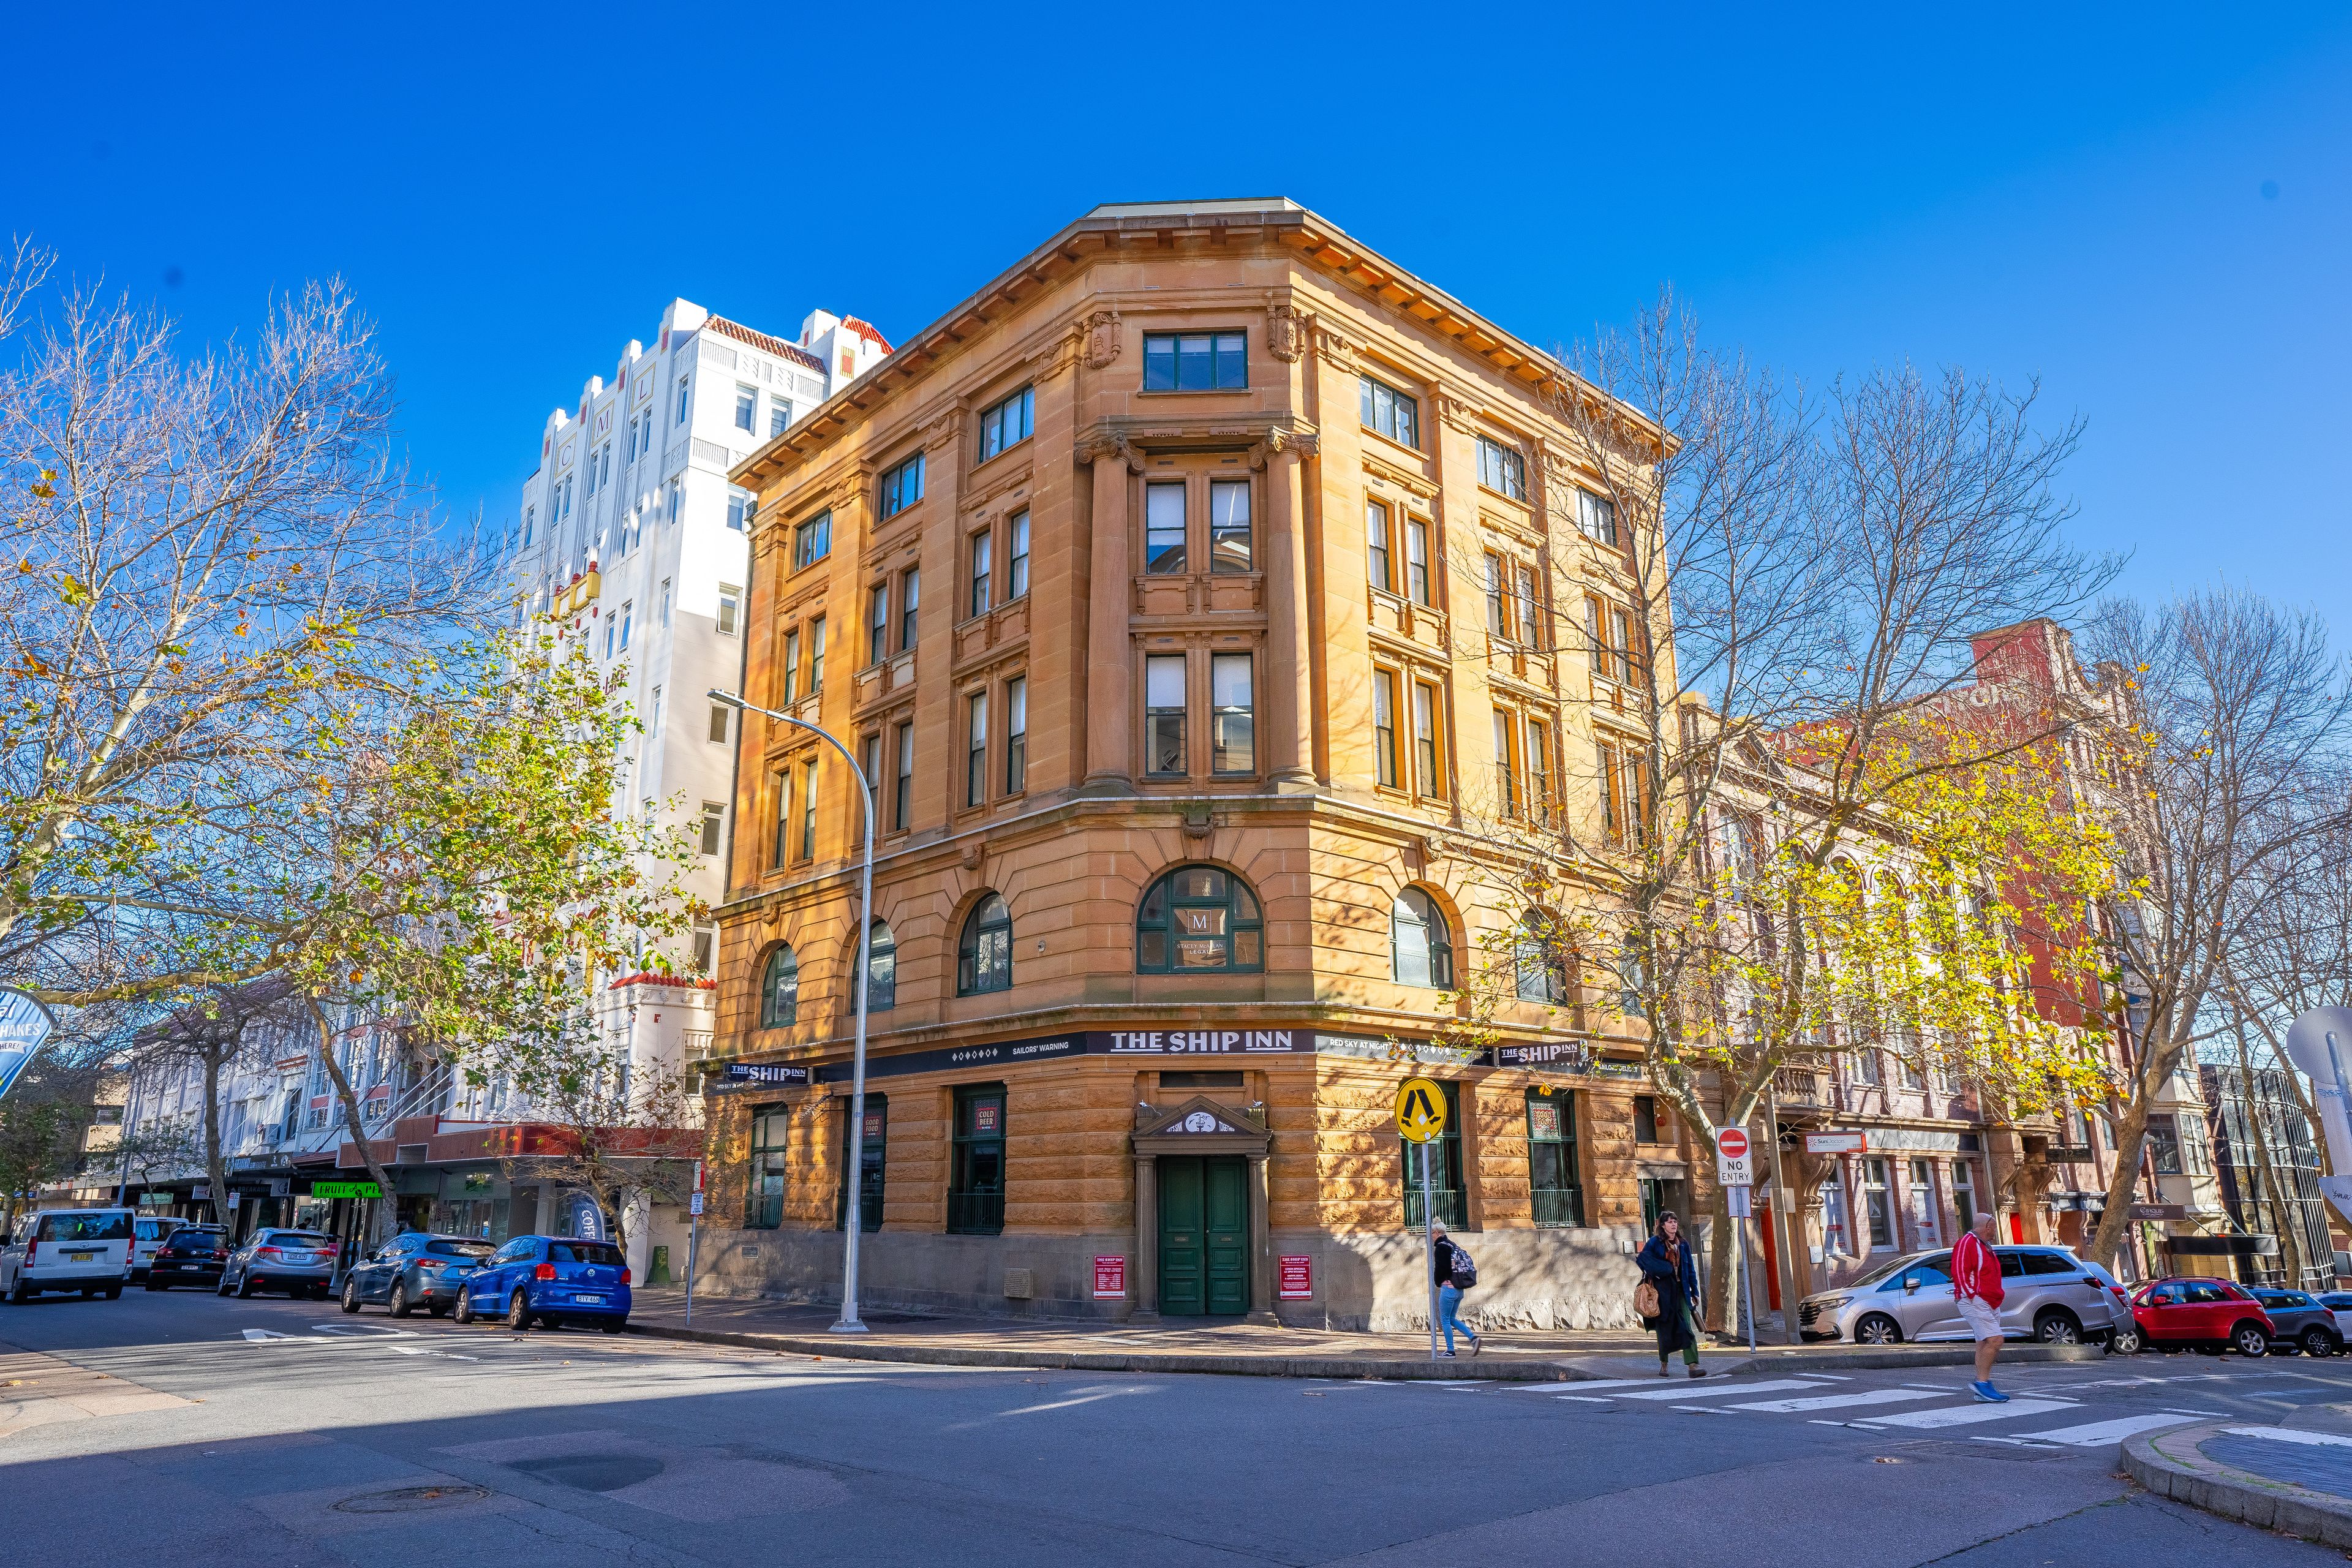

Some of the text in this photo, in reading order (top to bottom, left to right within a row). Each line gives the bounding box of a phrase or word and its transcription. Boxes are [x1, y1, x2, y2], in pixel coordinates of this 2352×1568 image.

[1193, 914, 1207, 929] M
[1110, 1031, 1292, 1052] THE SHIP INN
[1369, 1042, 1389, 1050] NIGHT
[1012, 1042, 1069, 1055] SAILORS' WARNING
[1501, 1043, 1578, 1063] THE SHIP INN
[748, 1066, 791, 1081] SHIP
[1727, 1161, 1743, 1170] NO
[1722, 1172, 1750, 1181] ENTRY
[320, 1185, 348, 1194] FRUIT
[365, 1185, 382, 1194] PE
